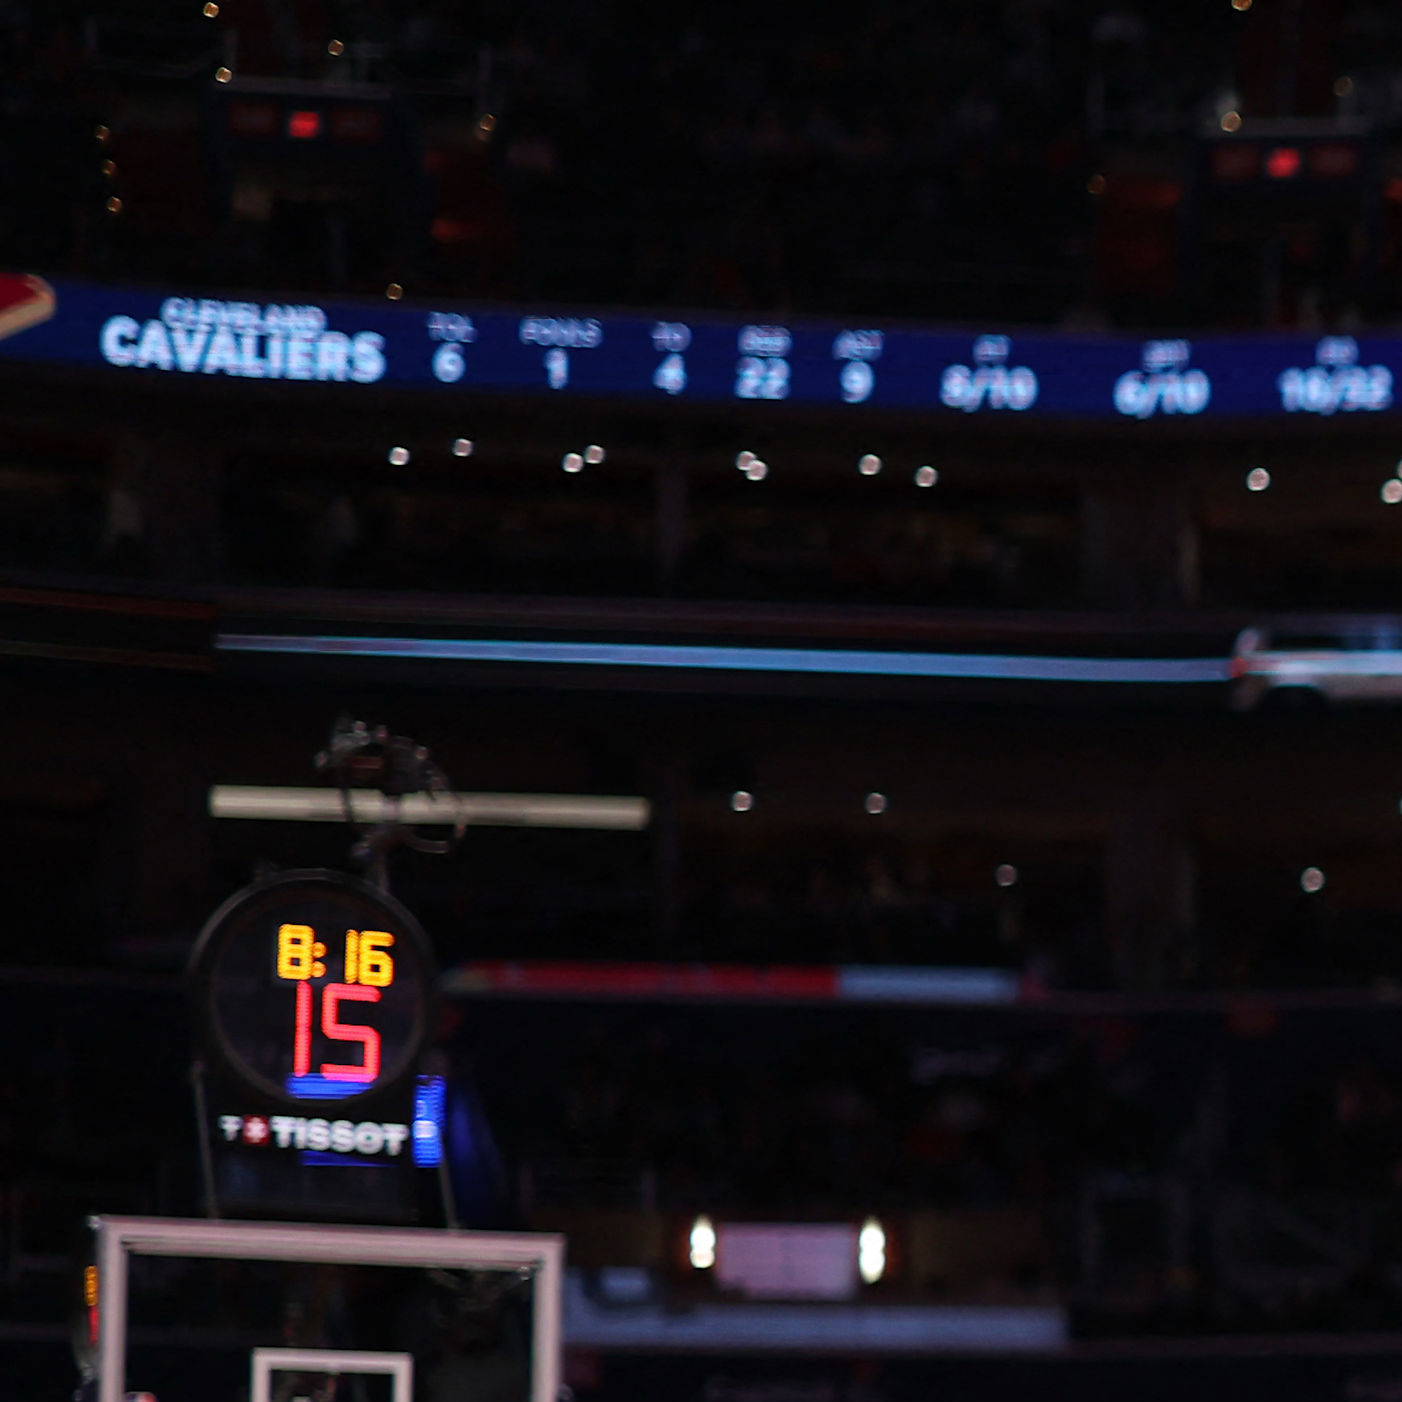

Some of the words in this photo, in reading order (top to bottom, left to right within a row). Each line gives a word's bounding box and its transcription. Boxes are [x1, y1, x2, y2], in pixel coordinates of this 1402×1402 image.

[101, 314, 387, 384] CAVALIERS
[432, 341, 467, 384] 6
[545, 348, 570, 391] 1
[653, 352, 687, 395] 4
[735, 356, 792, 400] 22
[841, 360, 874, 403] 9
[277, 923, 395, 987] 8:16
[294, 980, 382, 1084] 15
[270, 1116, 410, 1156] TISSOT
